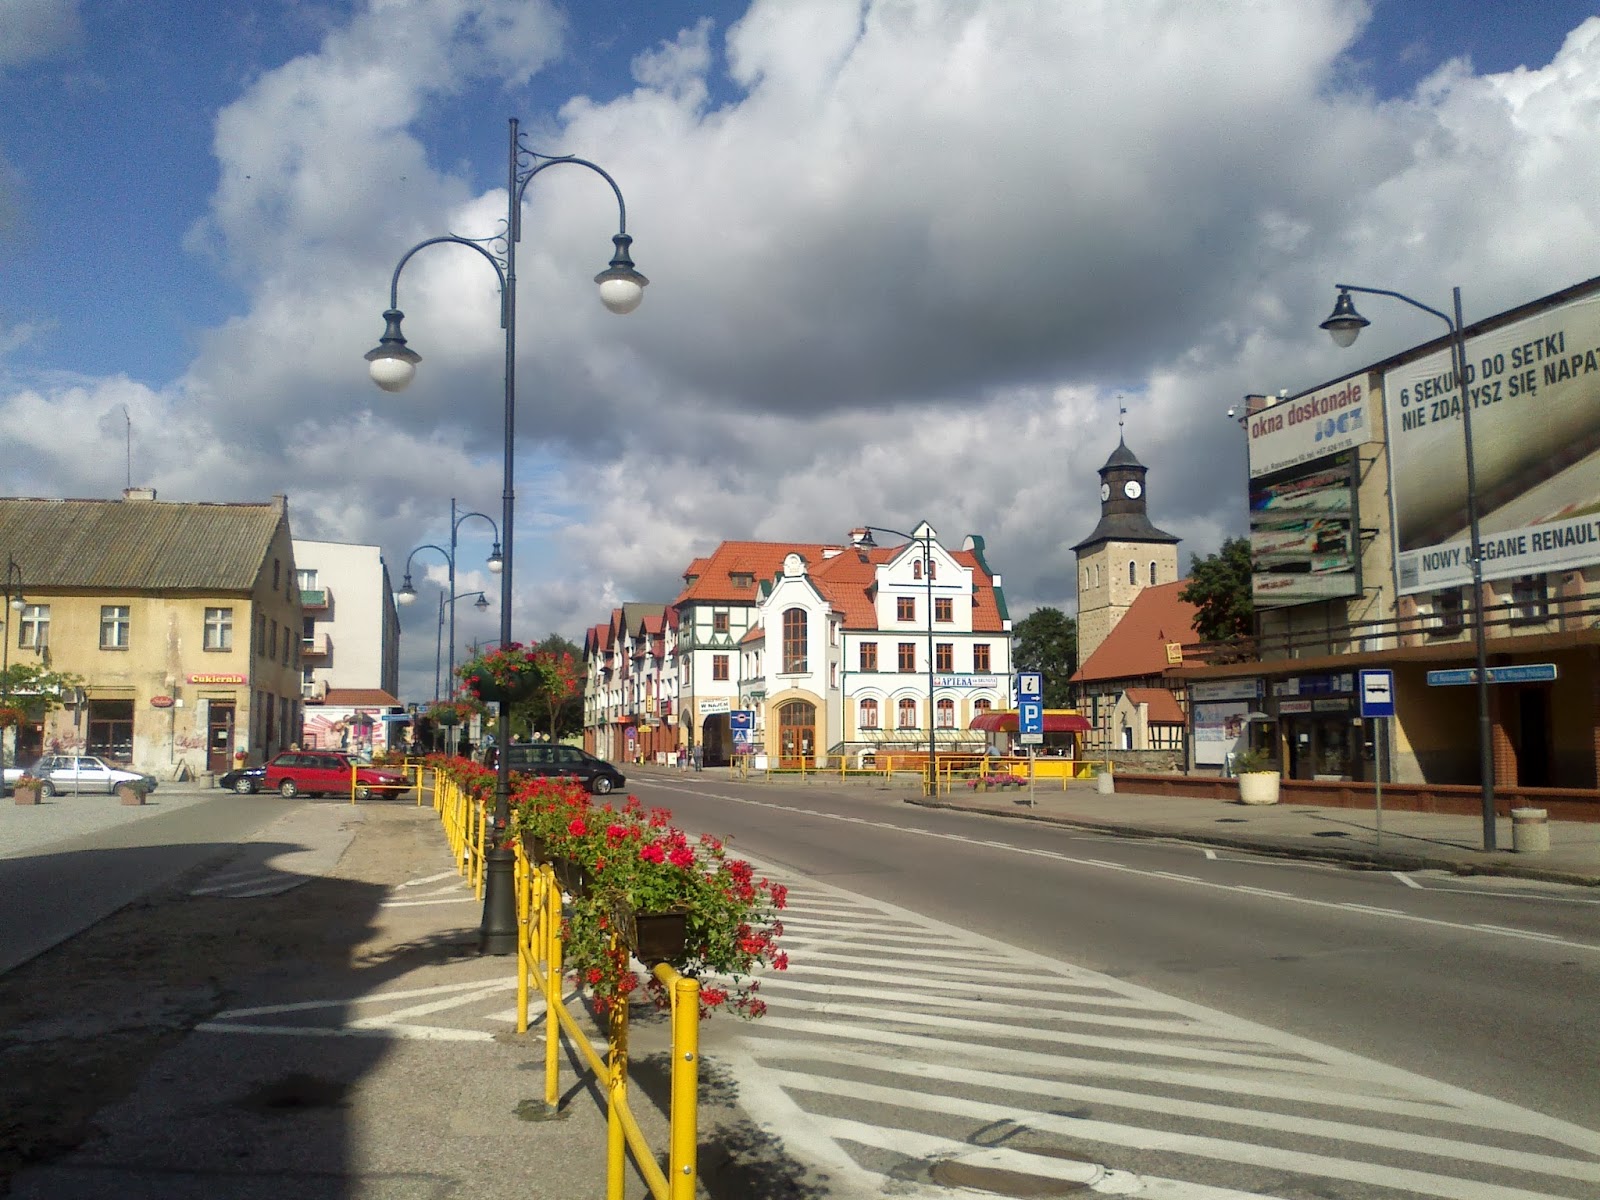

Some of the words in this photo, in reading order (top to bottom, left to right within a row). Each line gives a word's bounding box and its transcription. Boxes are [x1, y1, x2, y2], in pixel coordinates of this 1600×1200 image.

[1400, 388, 1410, 407] 6
[1481, 353, 1504, 380] DO
[1511, 331, 1565, 369] SETKI
[1402, 407, 1426, 432] NIE
[1430, 382, 1503, 422] ZDĄYSZ
[1508, 369, 1537, 397] SIĘ
[1543, 347, 1600, 387] NAPA
[1251, 413, 1283, 439] okna
[1422, 548, 1461, 572] NOWY
[191, 674, 242, 683] Cukiernia
[941, 676, 972, 686] APTEKA
[1025, 705, 1039, 724] P
